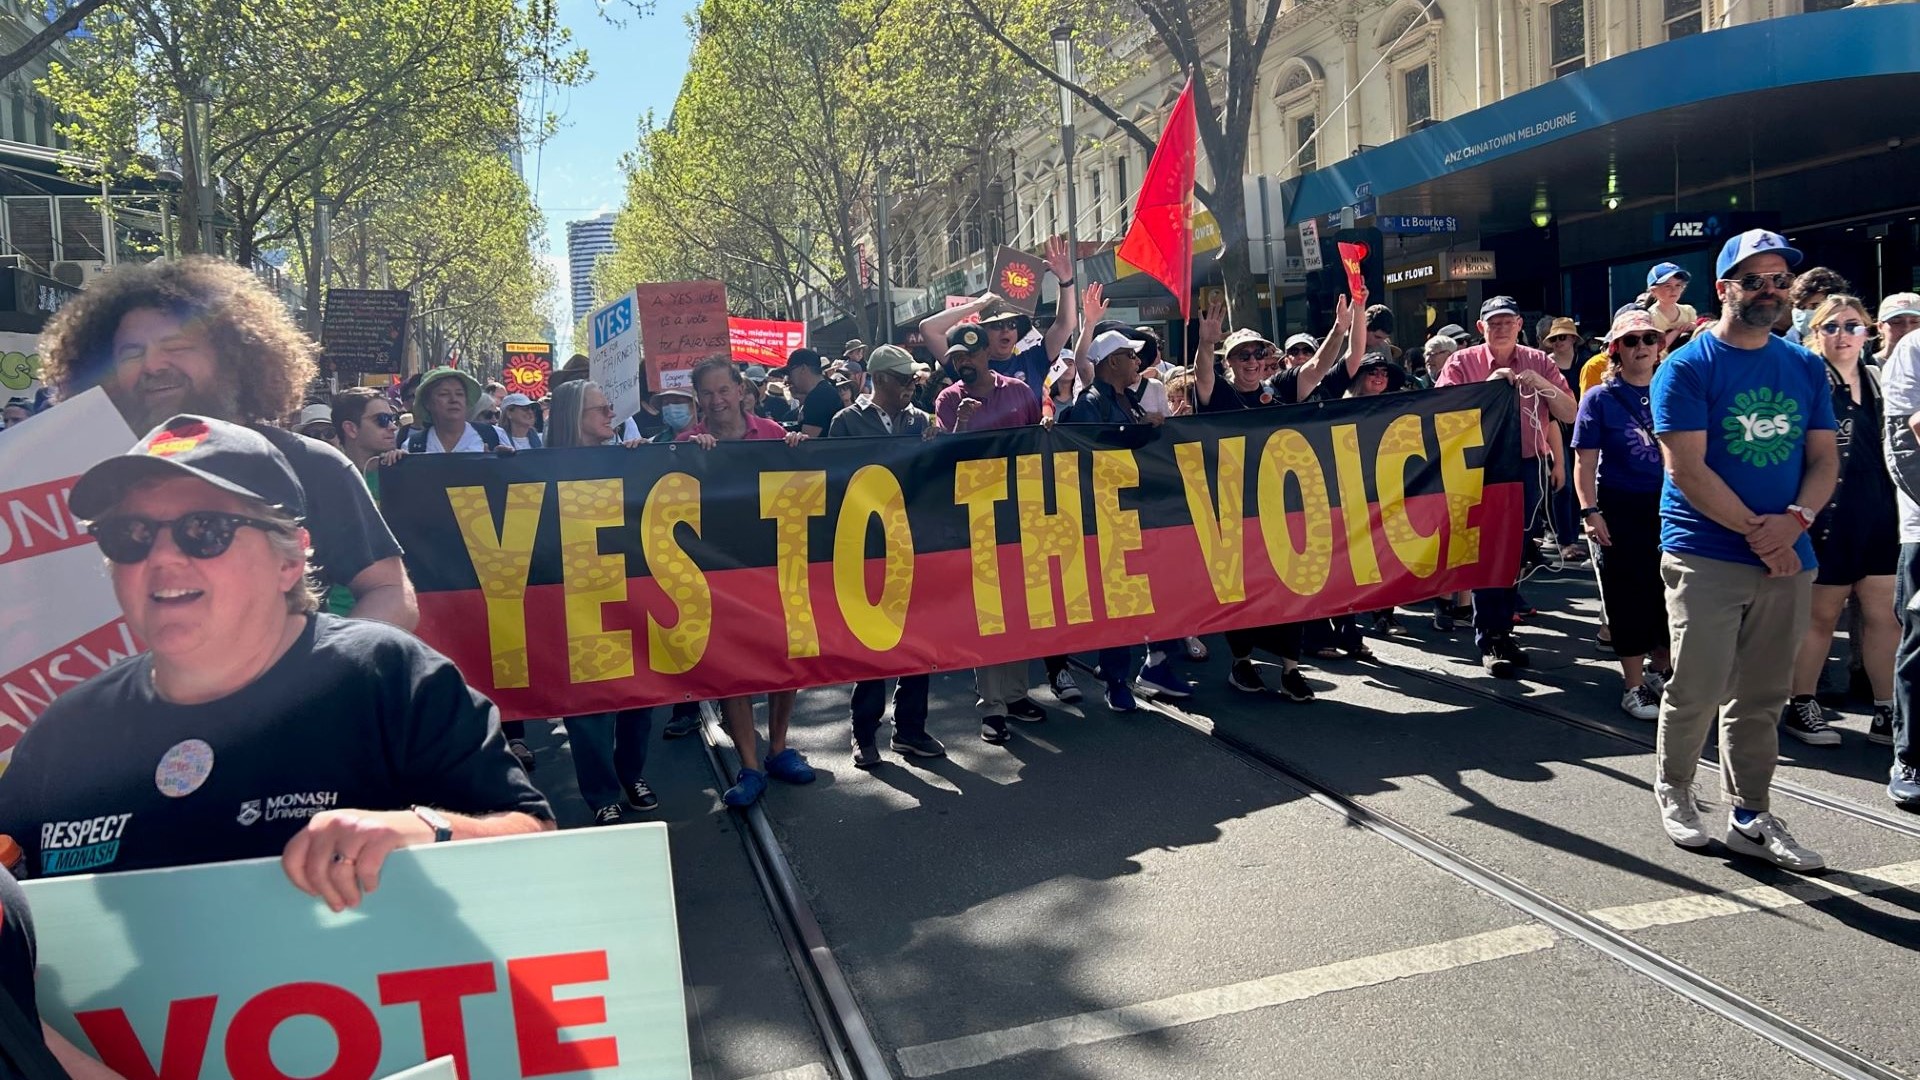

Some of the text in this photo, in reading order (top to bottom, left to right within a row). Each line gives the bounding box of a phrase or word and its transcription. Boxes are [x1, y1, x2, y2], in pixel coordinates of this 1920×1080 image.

[1445, 111, 1577, 165] ANZ CHINATOWN MELBOURNE
[1401, 216, 1456, 228] Lt Bourke St
[1670, 222, 1703, 237] ANZ
[1006, 271, 1028, 288] Yes
[1387, 265, 1434, 285] MILK FLOWER
[651, 296, 664, 307] A
[669, 291, 693, 306] YES
[596, 304, 630, 346] YES:
[687, 311, 708, 325] vote
[679, 333, 728, 350] FAIRNESS
[510, 367, 543, 384] Yes
[1736, 413, 1791, 442] Yes
[446, 408, 1485, 689] YES TO THE VOICE
[267, 791, 338, 808] MONASH
[41, 813, 133, 850] RESPECT
[55, 840, 117, 870] MONASH
[74, 949, 619, 1080] VOTE
